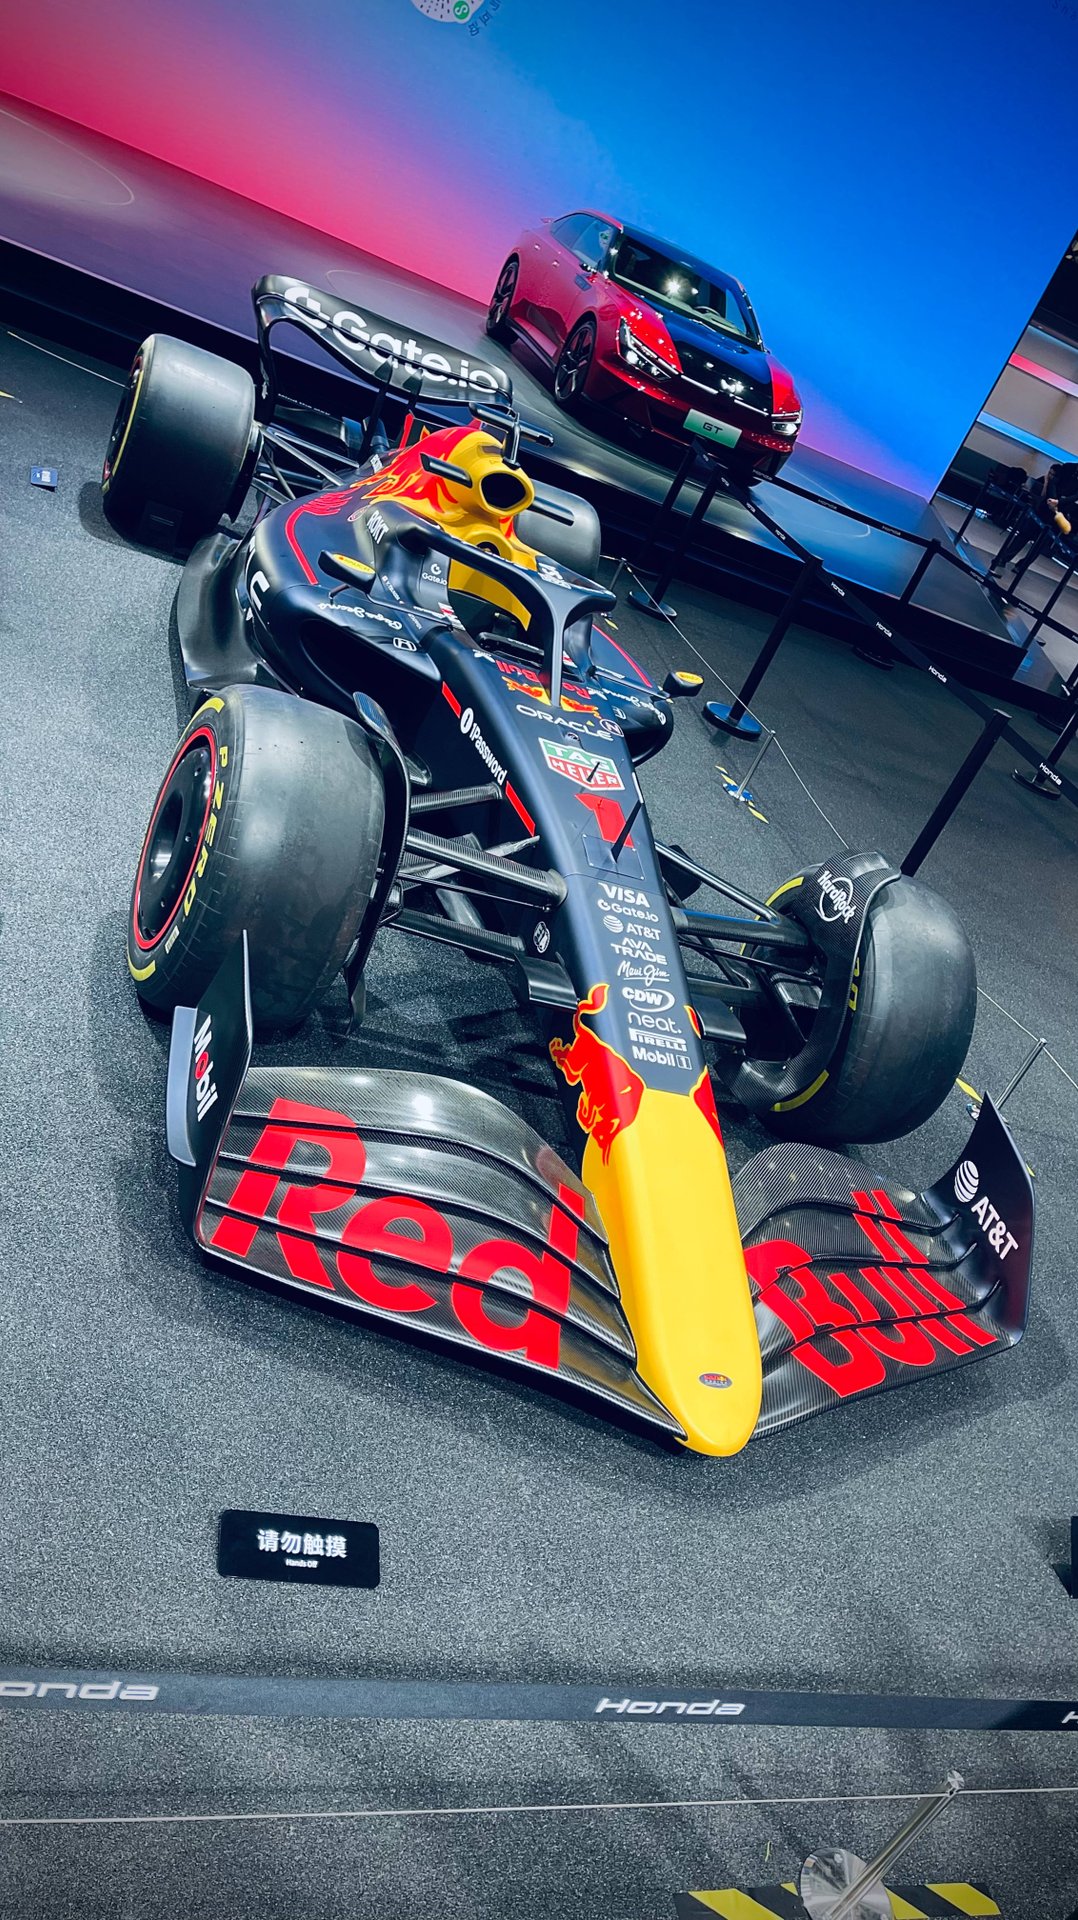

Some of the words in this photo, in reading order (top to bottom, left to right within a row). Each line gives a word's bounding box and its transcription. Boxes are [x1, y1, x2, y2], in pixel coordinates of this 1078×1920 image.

[332, 311, 499, 394] Gate.io
[702, 421, 724, 434] GT
[366, 510, 389, 544] ROKT
[875, 621, 893, 639] Honda
[928, 665, 948, 684] Honda
[516, 703, 614, 741] ORACLE
[469, 722, 508, 786] 1Password
[550, 743, 609, 770] TAG
[549, 758, 619, 785] HEUER
[1039, 762, 1063, 786] Honda
[598, 882, 650, 908] VISA
[611, 903, 659, 922] Gate.io
[626, 922, 661, 941] AT&T
[610, 943, 668, 965] TRADE
[622, 937, 653, 952] AVA
[616, 960, 643, 978] Maui
[643, 964, 670, 987] Jim
[621, 986, 663, 1006] CDW
[627, 1011, 682, 1034] neat.
[628, 1028, 687, 1052] PIRELLI
[632, 1045, 676, 1067] Mobil
[194, 1014, 219, 1123] Mobil
[209, 1097, 586, 1371] Red
[971, 1196, 1019, 1260] AT&T
[742, 1189, 999, 1399] Bull
[256, 1528, 348, 1558] 请勿触摸
[285, 1558, 307, 1568] Hands
[307, 1560, 319, 1568] Off
[595, 1697, 746, 1717] Honda
